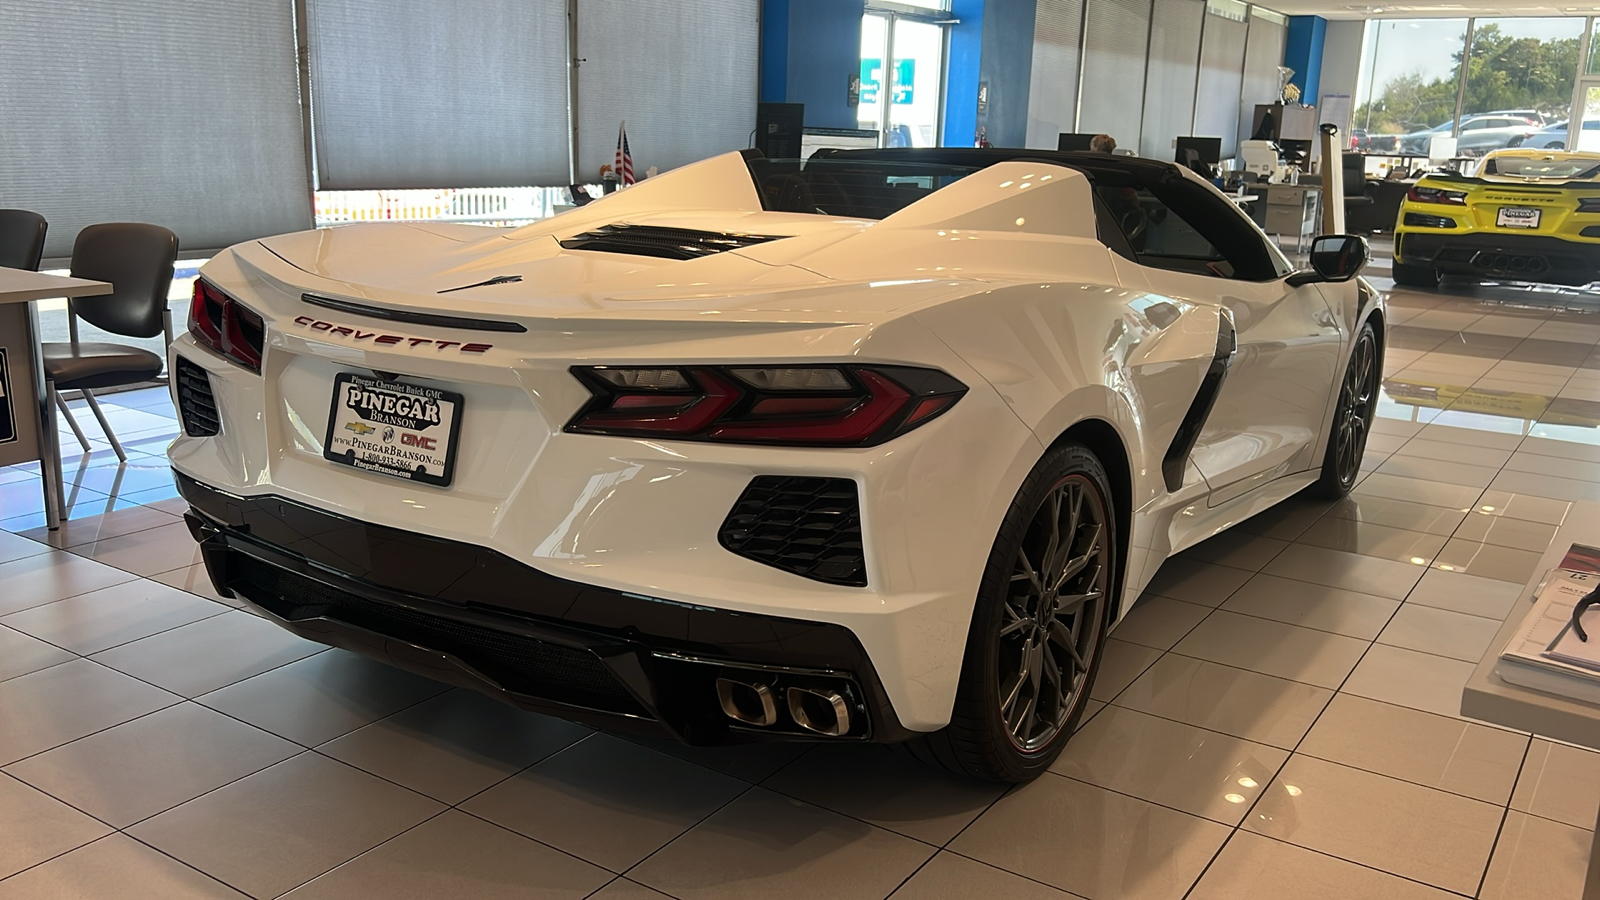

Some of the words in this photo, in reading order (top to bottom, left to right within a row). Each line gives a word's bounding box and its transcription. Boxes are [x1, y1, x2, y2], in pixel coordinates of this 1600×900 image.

[294, 315, 494, 353] CORVETTE
[351, 375, 375, 387] Pinegar
[376, 380, 405, 393] Chevrolet
[406, 385, 424, 396] Buick
[425, 389, 443, 399] GMC
[348, 389, 439, 423] PINEGAR
[370, 409, 417, 429] BRANSON
[400, 432, 437, 451] GMC
[353, 459, 412, 478] PinegarBranson.com
[361, 451, 412, 469] 1-800-933-5866
